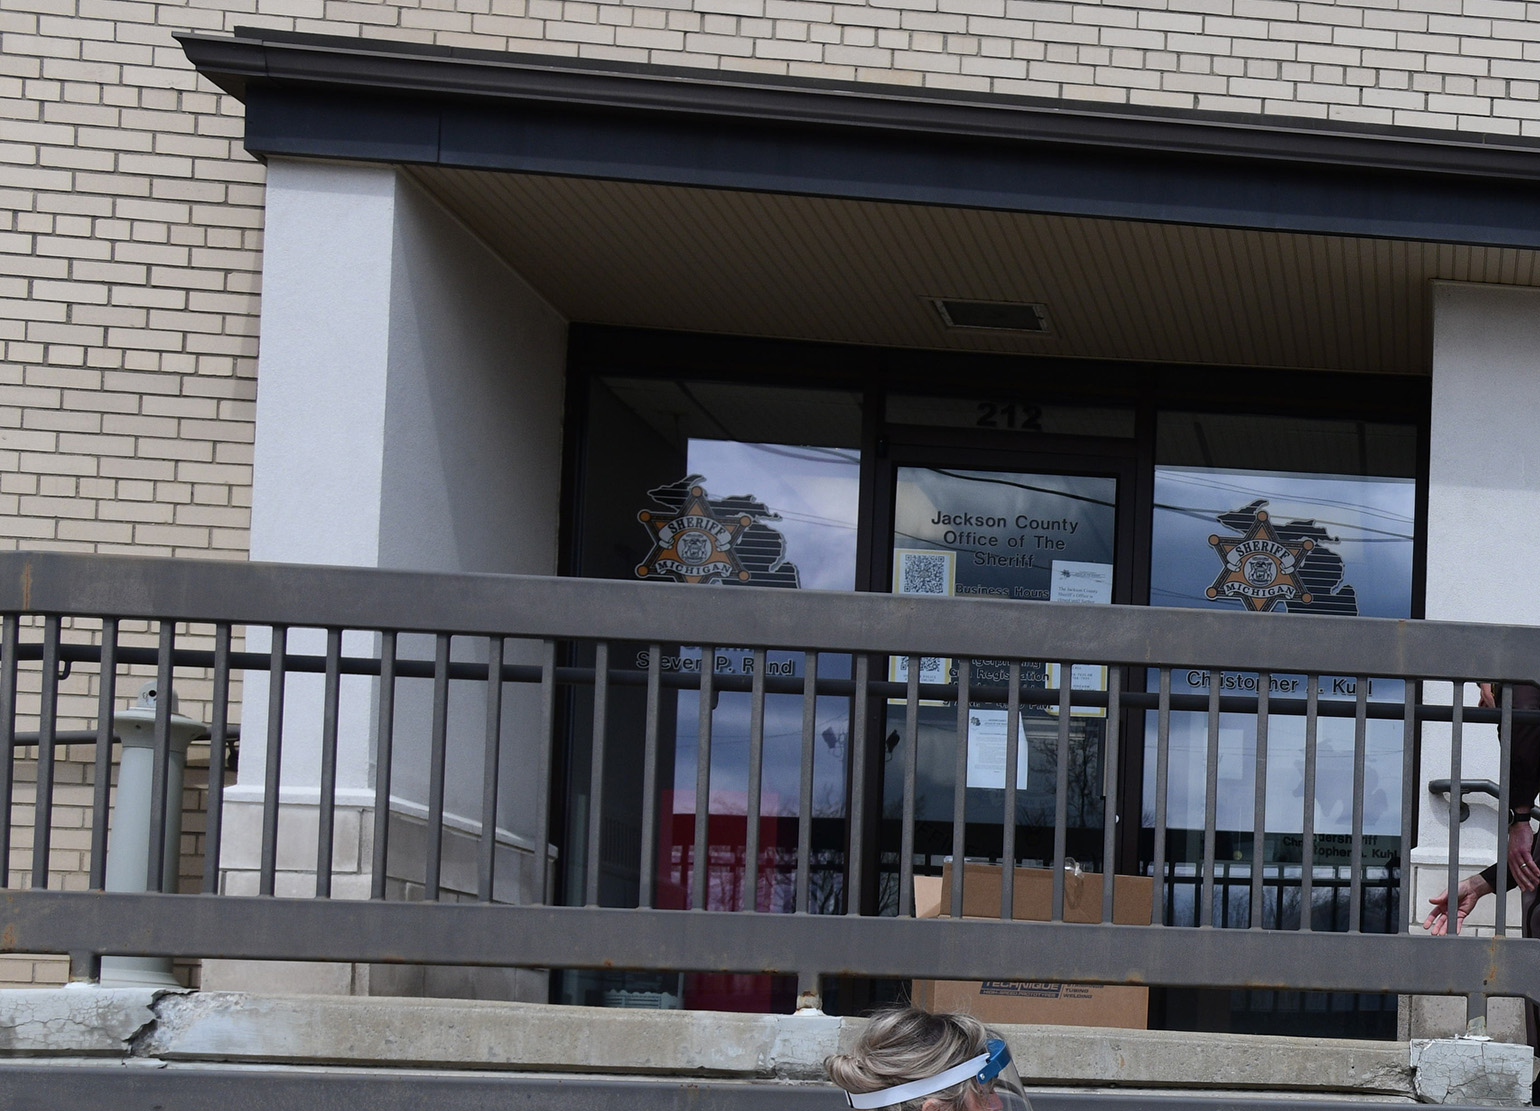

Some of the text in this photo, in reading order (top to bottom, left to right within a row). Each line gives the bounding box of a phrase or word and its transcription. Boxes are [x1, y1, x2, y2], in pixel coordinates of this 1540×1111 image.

[976, 402, 1043, 430] 212
[667, 517, 727, 537] SHERIFF
[931, 511, 1079, 534] Jackson County
[943, 530, 1066, 550] Office of The
[1235, 540, 1290, 560] SHERIFF
[658, 561, 731, 575] MICHIGAN
[973, 551, 1035, 569] Sheriff
[955, 583, 1049, 599] Business Hours
[1225, 583, 1295, 597] MICHIGAN
[636, 651, 794, 675] Seven P. Rnd
[976, 668, 1050, 682] Regisation
[1187, 670, 1299, 692] Chistoher
[1332, 678, 1373, 696] Kul
